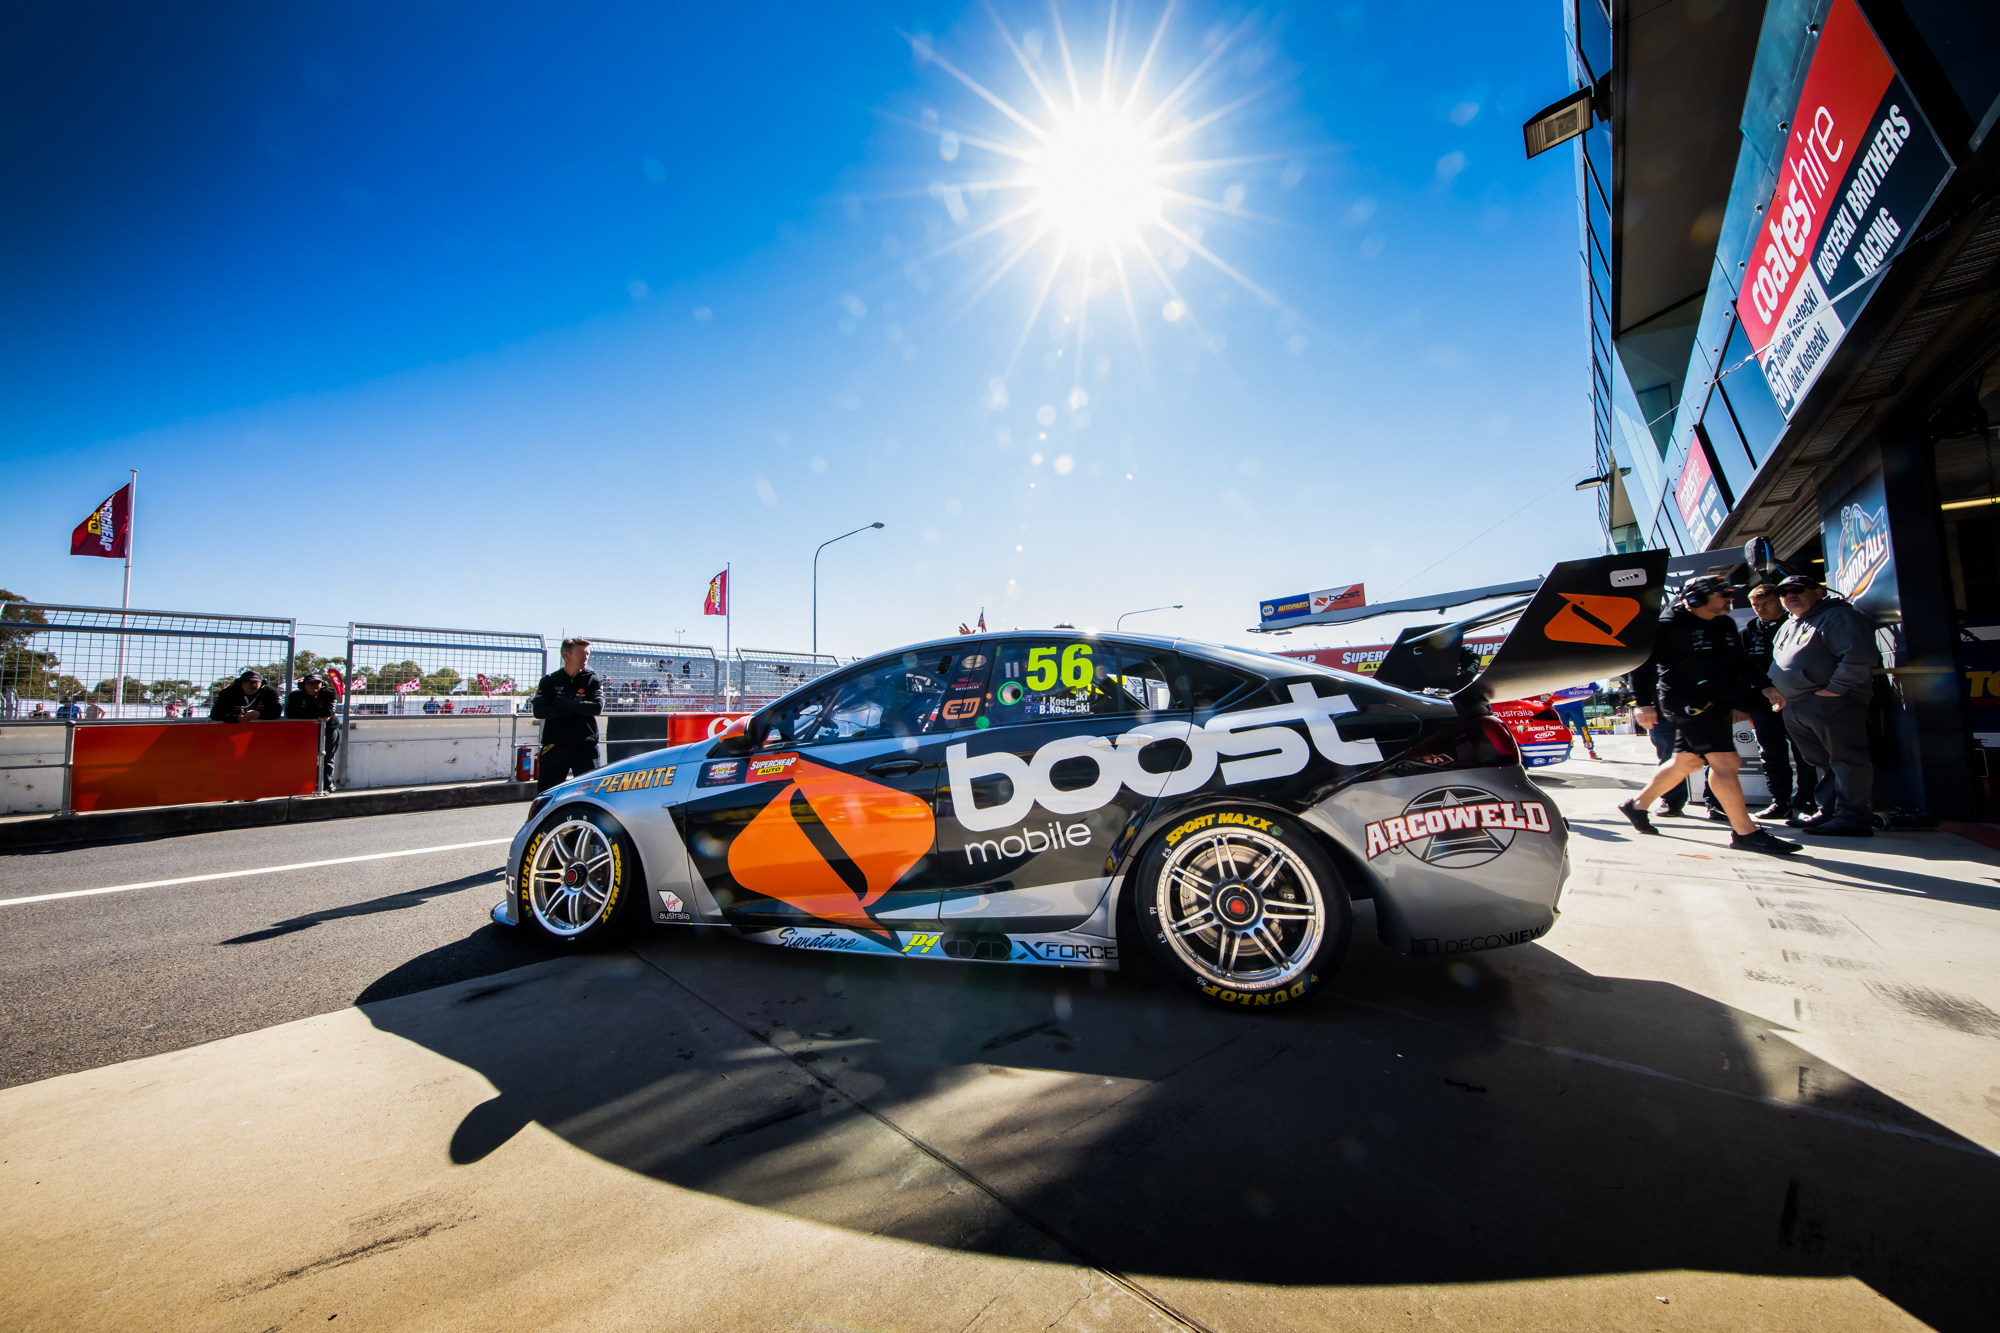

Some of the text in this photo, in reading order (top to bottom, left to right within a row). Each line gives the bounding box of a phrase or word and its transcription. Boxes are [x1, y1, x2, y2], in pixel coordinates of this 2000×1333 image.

[1816, 104, 1911, 285] KOSTECKI BROTHERS
[1853, 206, 1901, 277] RACING
[1787, 321, 1830, 394] Jake Kostecki
[1329, 590, 1361, 602] boost
[1026, 644, 1094, 691] 56
[1493, 710, 1534, 718] australia
[592, 765, 677, 794] PENRITE
[750, 757, 796, 770] SUPERCHEAP
[945, 682, 1384, 832] boost
[964, 821, 1093, 866] mobile
[1165, 812, 1273, 847] SPORT MAXX
[1365, 801, 1551, 861] ARCOWELD
[522, 833, 542, 901] DUNLOP
[601, 843, 622, 924] SPORT MAXX
[659, 912, 690, 920] australia
[777, 927, 860, 950] Signature
[1202, 981, 1305, 1006] DUNLOP
